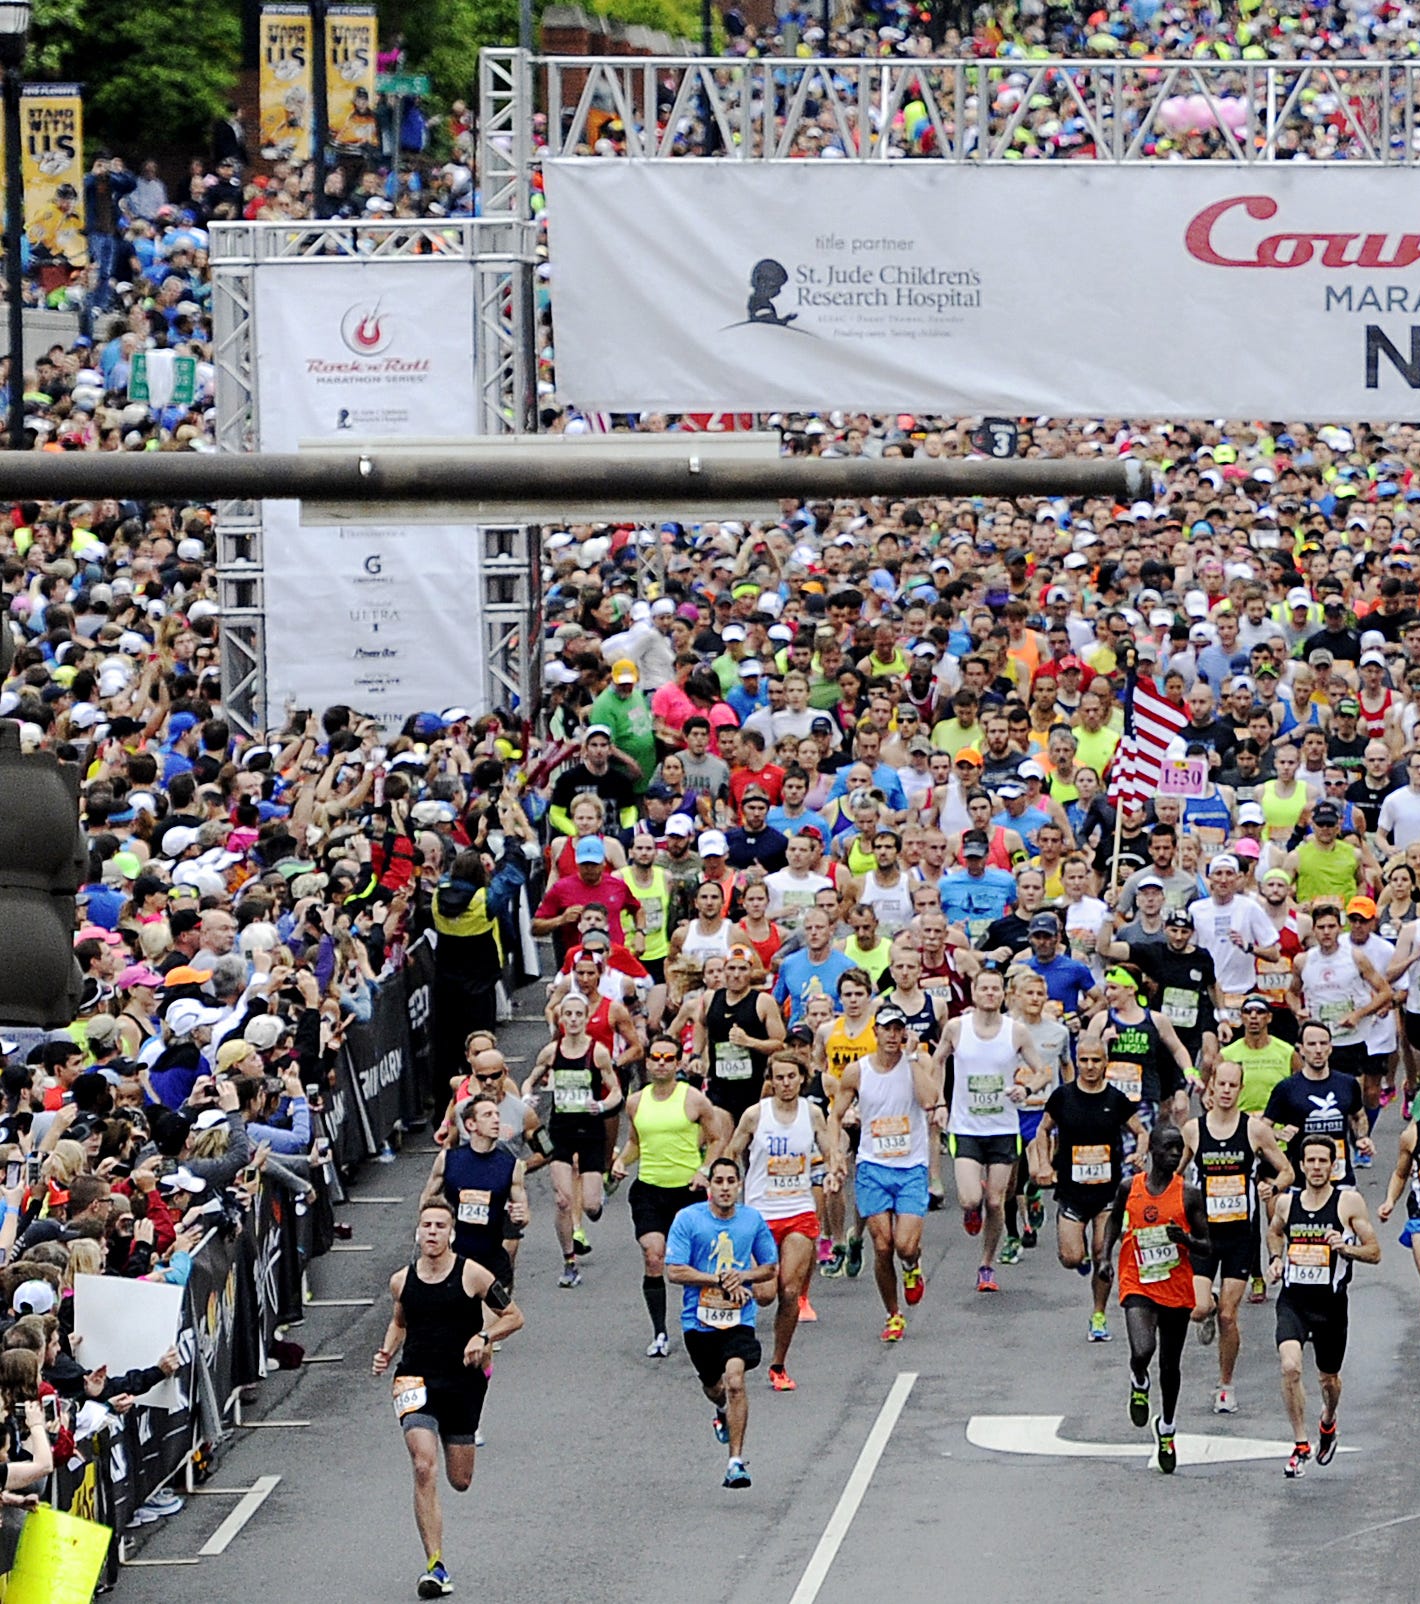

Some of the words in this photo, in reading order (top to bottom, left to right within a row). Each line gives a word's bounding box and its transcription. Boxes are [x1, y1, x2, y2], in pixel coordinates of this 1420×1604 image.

[268, 25, 305, 33] STAND
[331, 25, 369, 33] STAND
[28, 109, 73, 119] STAND
[29, 120, 74, 132] WITH
[29, 135, 75, 159] US
[815, 233, 846, 250] title
[852, 237, 915, 254] partner
[796, 265, 822, 285] St.
[828, 265, 874, 288] Jude
[879, 265, 982, 287] Children's
[796, 287, 888, 307] Research
[896, 287, 981, 313] Hospital
[306, 358, 361, 373] Rock
[383, 357, 431, 373] Roll
[316, 375, 382, 385] MARATHON
[993, 432, 1010, 457] 3
[364, 555, 382, 575] G
[1164, 768, 1202, 786] 1:30
[1117, 1032, 1149, 1043] NDER
[1213, 1198, 1241, 1210] 1625
[1142, 1247, 1172, 1263] 1190
[1294, 1267, 1322, 1280] 1667
[704, 1309, 734, 1322] 1698
